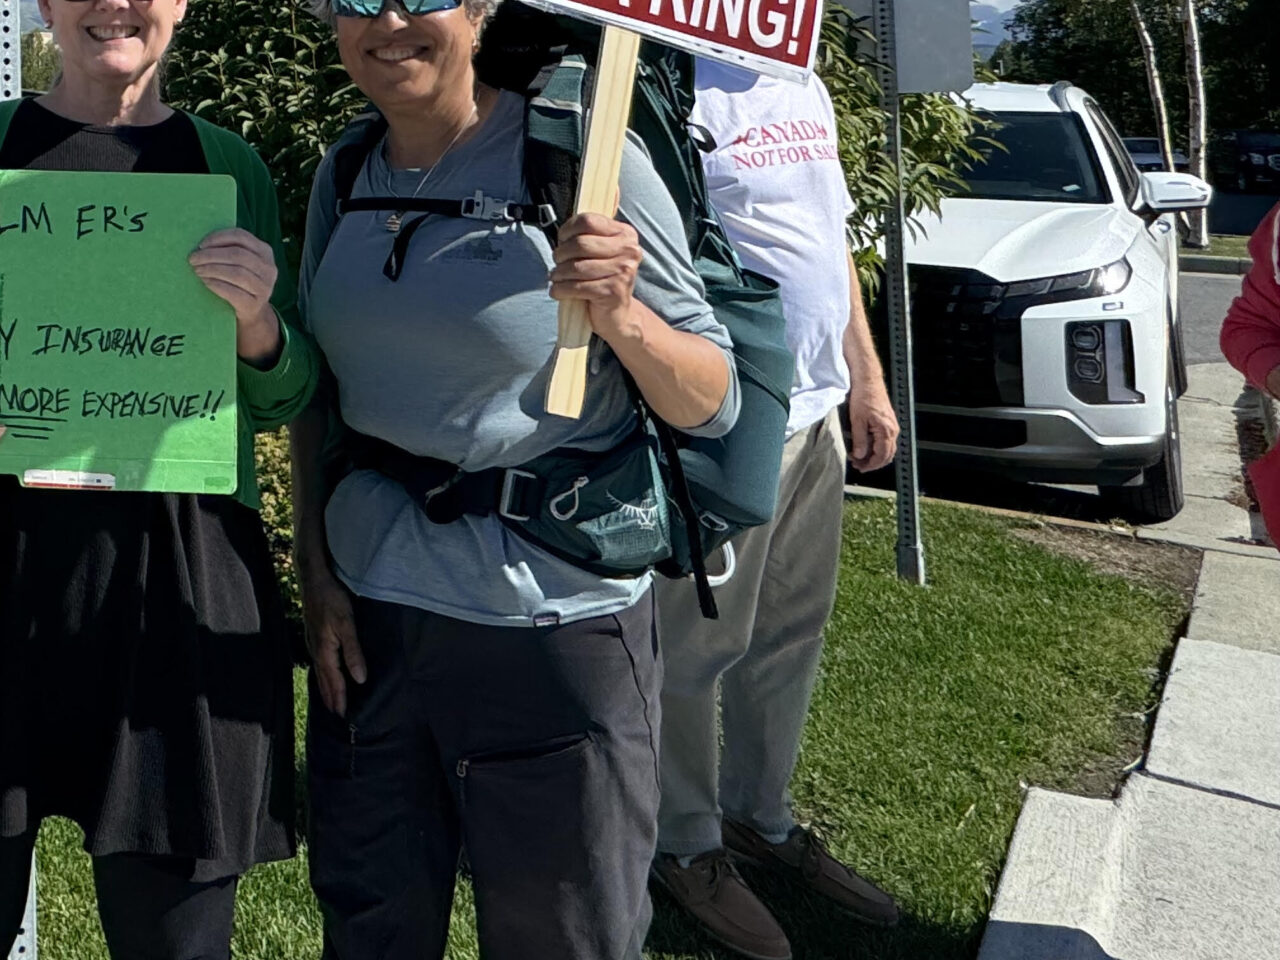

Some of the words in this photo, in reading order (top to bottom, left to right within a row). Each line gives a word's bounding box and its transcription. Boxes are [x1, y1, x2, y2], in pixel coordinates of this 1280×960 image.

[732, 148, 775, 170] NOT
[779, 145, 814, 164] FOR
[81, 390, 225, 422] EXPENSIVE!!
